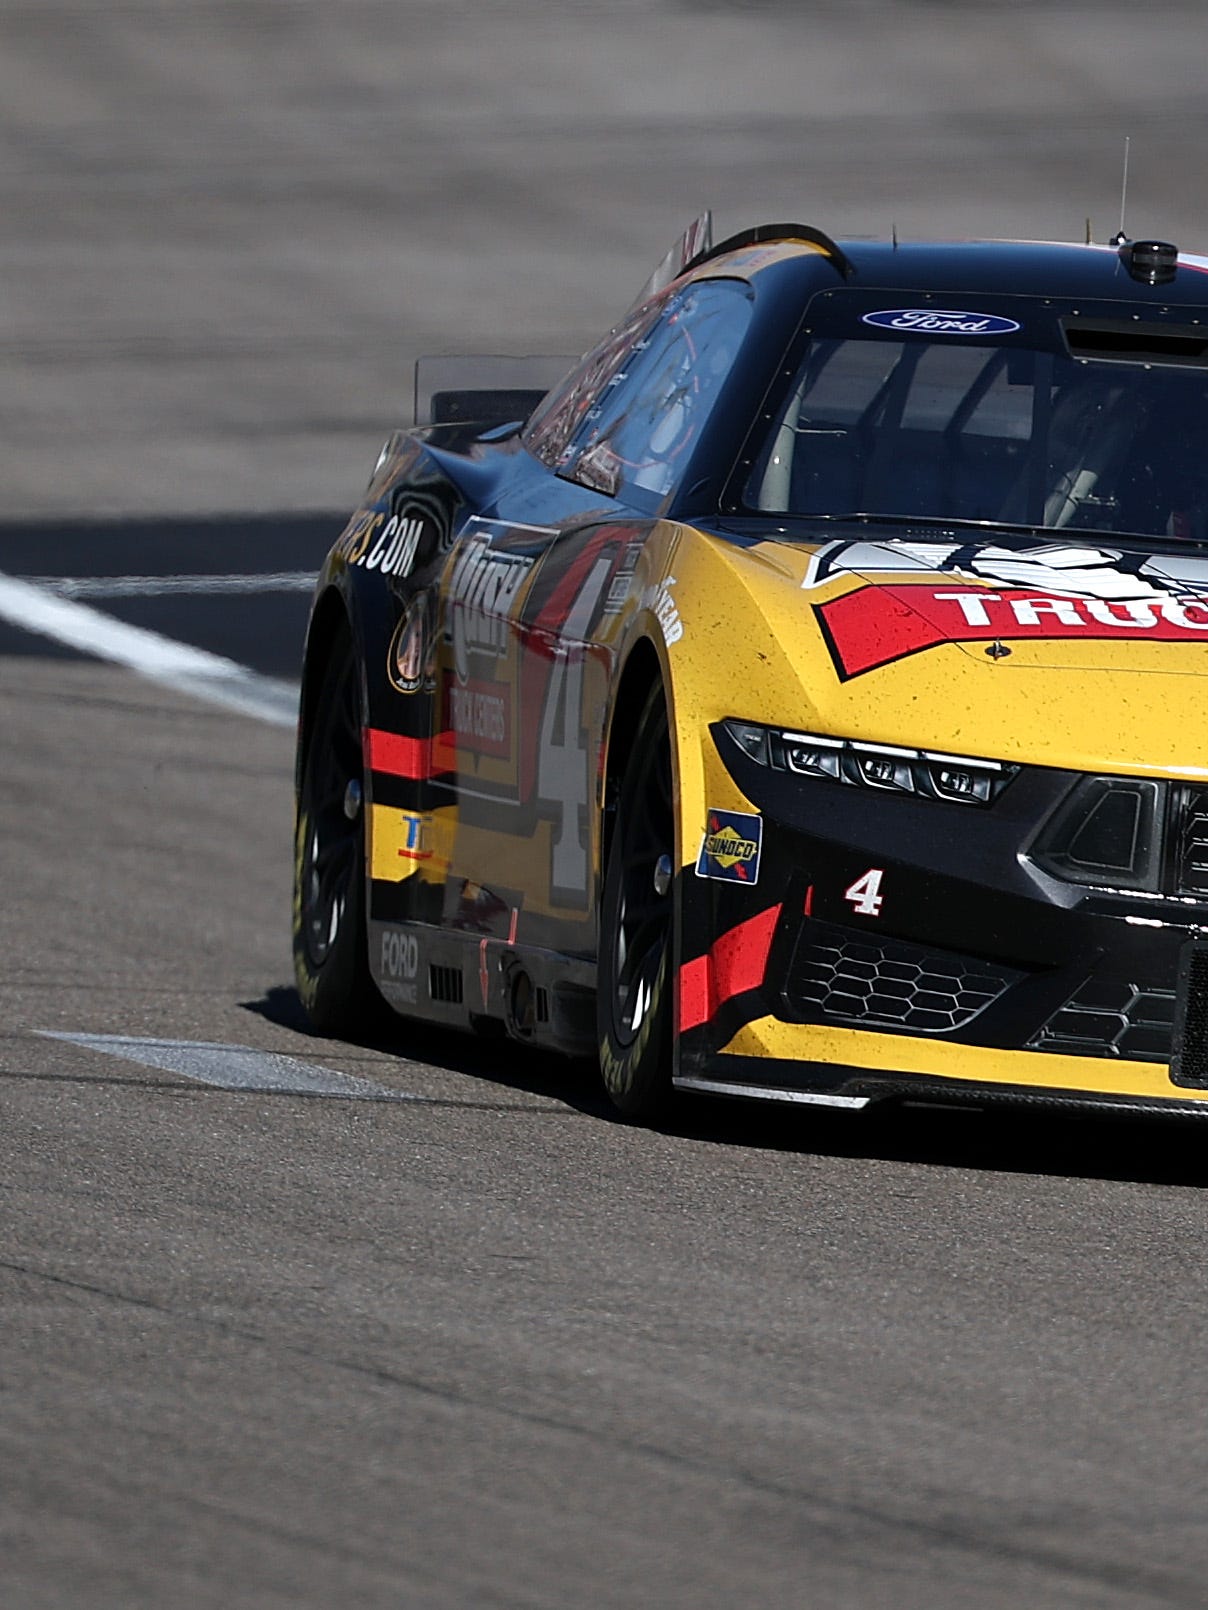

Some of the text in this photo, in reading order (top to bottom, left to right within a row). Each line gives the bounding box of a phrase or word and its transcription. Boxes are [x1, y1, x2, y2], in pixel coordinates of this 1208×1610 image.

[890, 310, 988, 332] Ford
[706, 836, 753, 859] SUNOCO
[844, 868, 885, 917] 4
[381, 930, 419, 979] FORD
